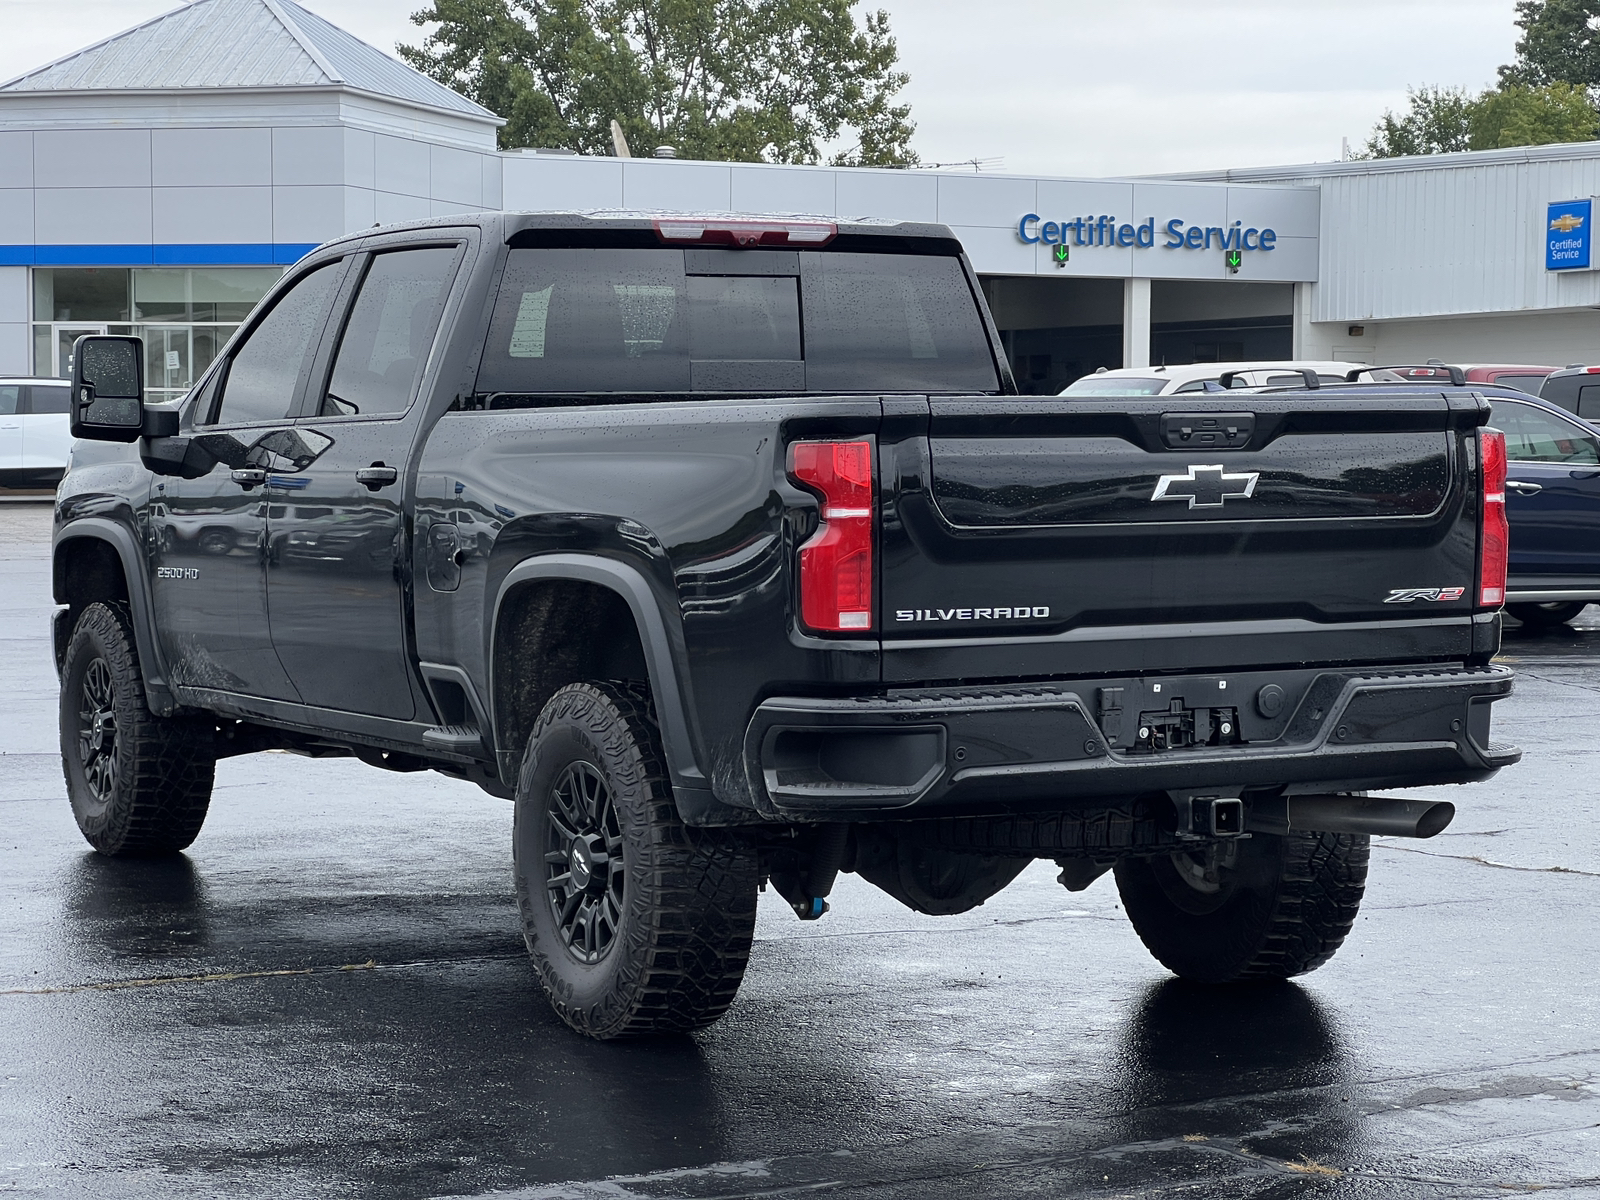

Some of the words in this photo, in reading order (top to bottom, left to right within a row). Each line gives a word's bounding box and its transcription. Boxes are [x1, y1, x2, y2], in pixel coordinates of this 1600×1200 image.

[1018, 213, 1155, 248] Certified
[1166, 218, 1277, 251] Service
[1550, 238, 1582, 250] Certified
[1552, 249, 1580, 260] Service
[157, 566, 183, 578] 2500
[1382, 586, 1466, 604] ZR2
[895, 606, 1050, 622] SILVERADO
